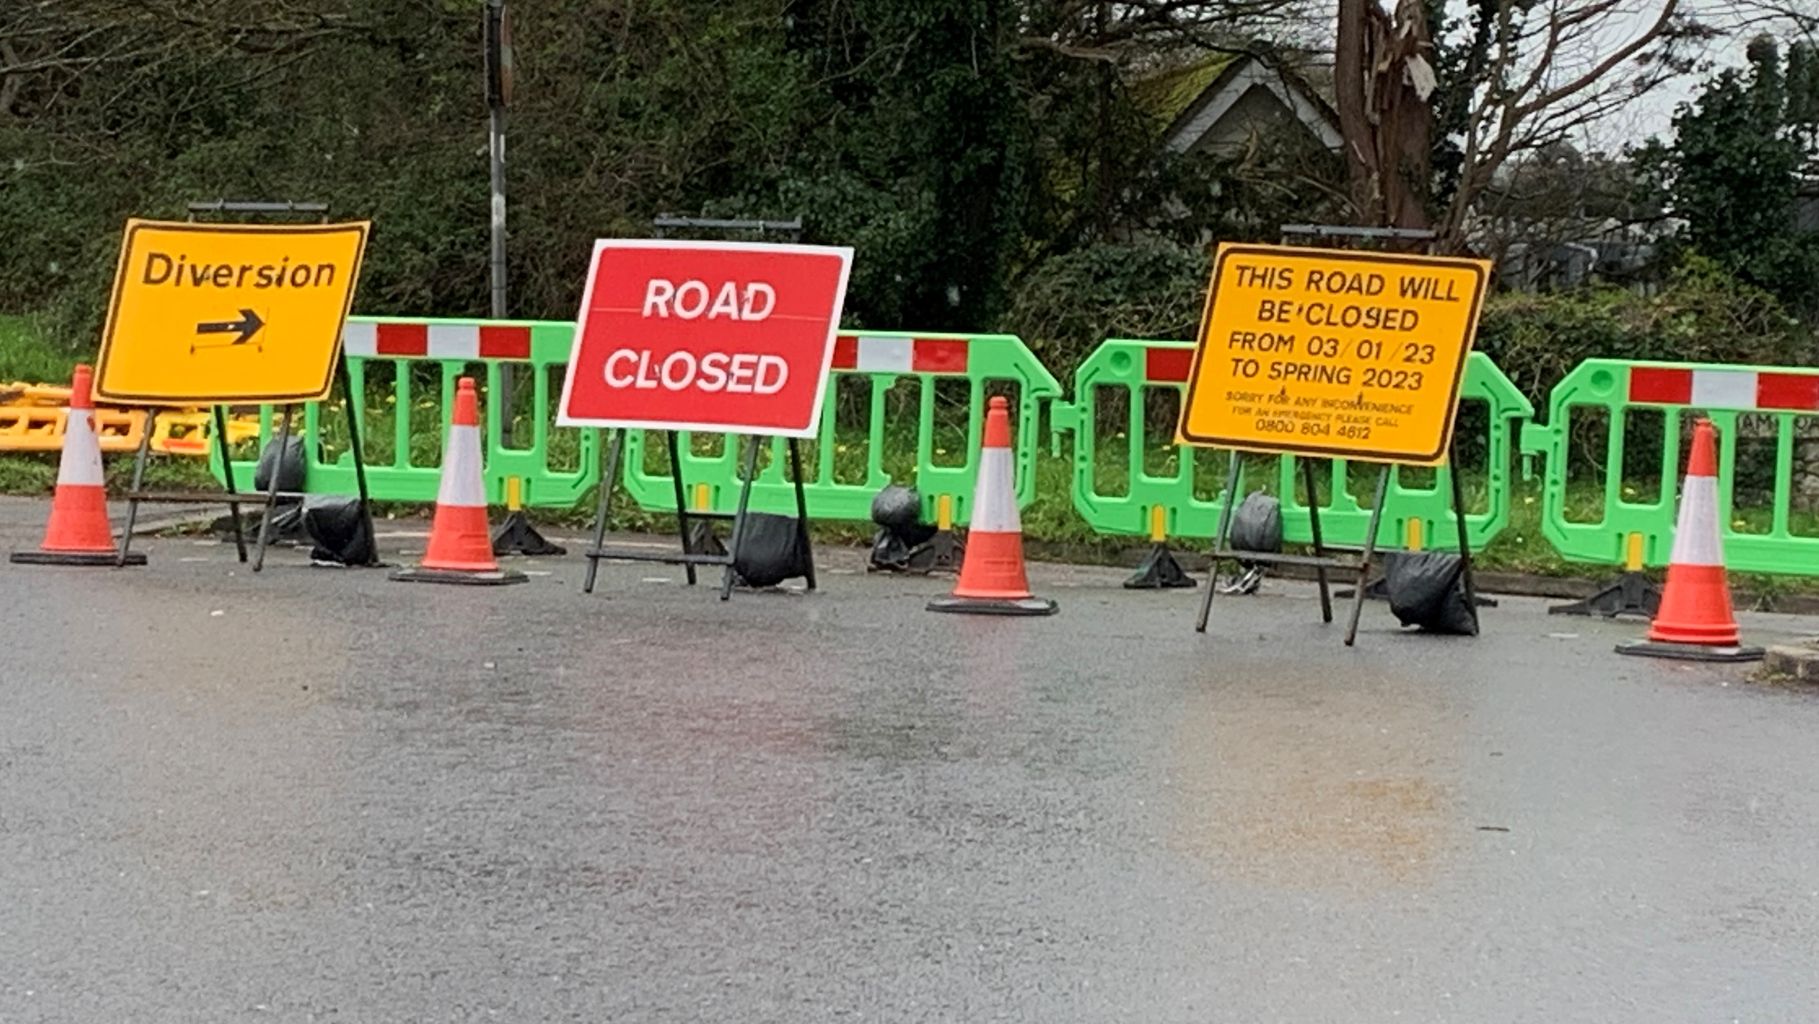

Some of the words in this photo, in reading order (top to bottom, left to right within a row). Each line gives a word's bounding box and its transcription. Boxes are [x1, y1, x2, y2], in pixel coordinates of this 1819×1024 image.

[142, 252, 336, 288] Diversion
[1235, 265, 1294, 290] THIS
[1305, 270, 1385, 297] ROAD
[1399, 276, 1460, 302] WILL
[642, 279, 776, 321] ROAD
[1258, 299, 1293, 323] BE
[1305, 302, 1419, 332] CLOSED
[1228, 331, 1295, 354] FROM
[603, 348, 789, 395] CLOSED
[1231, 358, 1259, 378] TO
[1268, 361, 1352, 385] SPRING
[1362, 367, 1424, 391] 2023
[1225, 391, 1264, 404] SORRY
[1268, 393, 1290, 405] FOR
[1294, 396, 1318, 407] ANY
[1320, 398, 1414, 415] INCONVENIENCE
[1232, 406, 1252, 415] FOR
[1254, 407, 1270, 416] AN
[1335, 413, 1371, 425] PLEASE
[1375, 417, 1399, 427] CALL
[1255, 418, 1295, 433] 0800
[1300, 422, 1331, 436] 804
[1337, 425, 1372, 440] 4612
